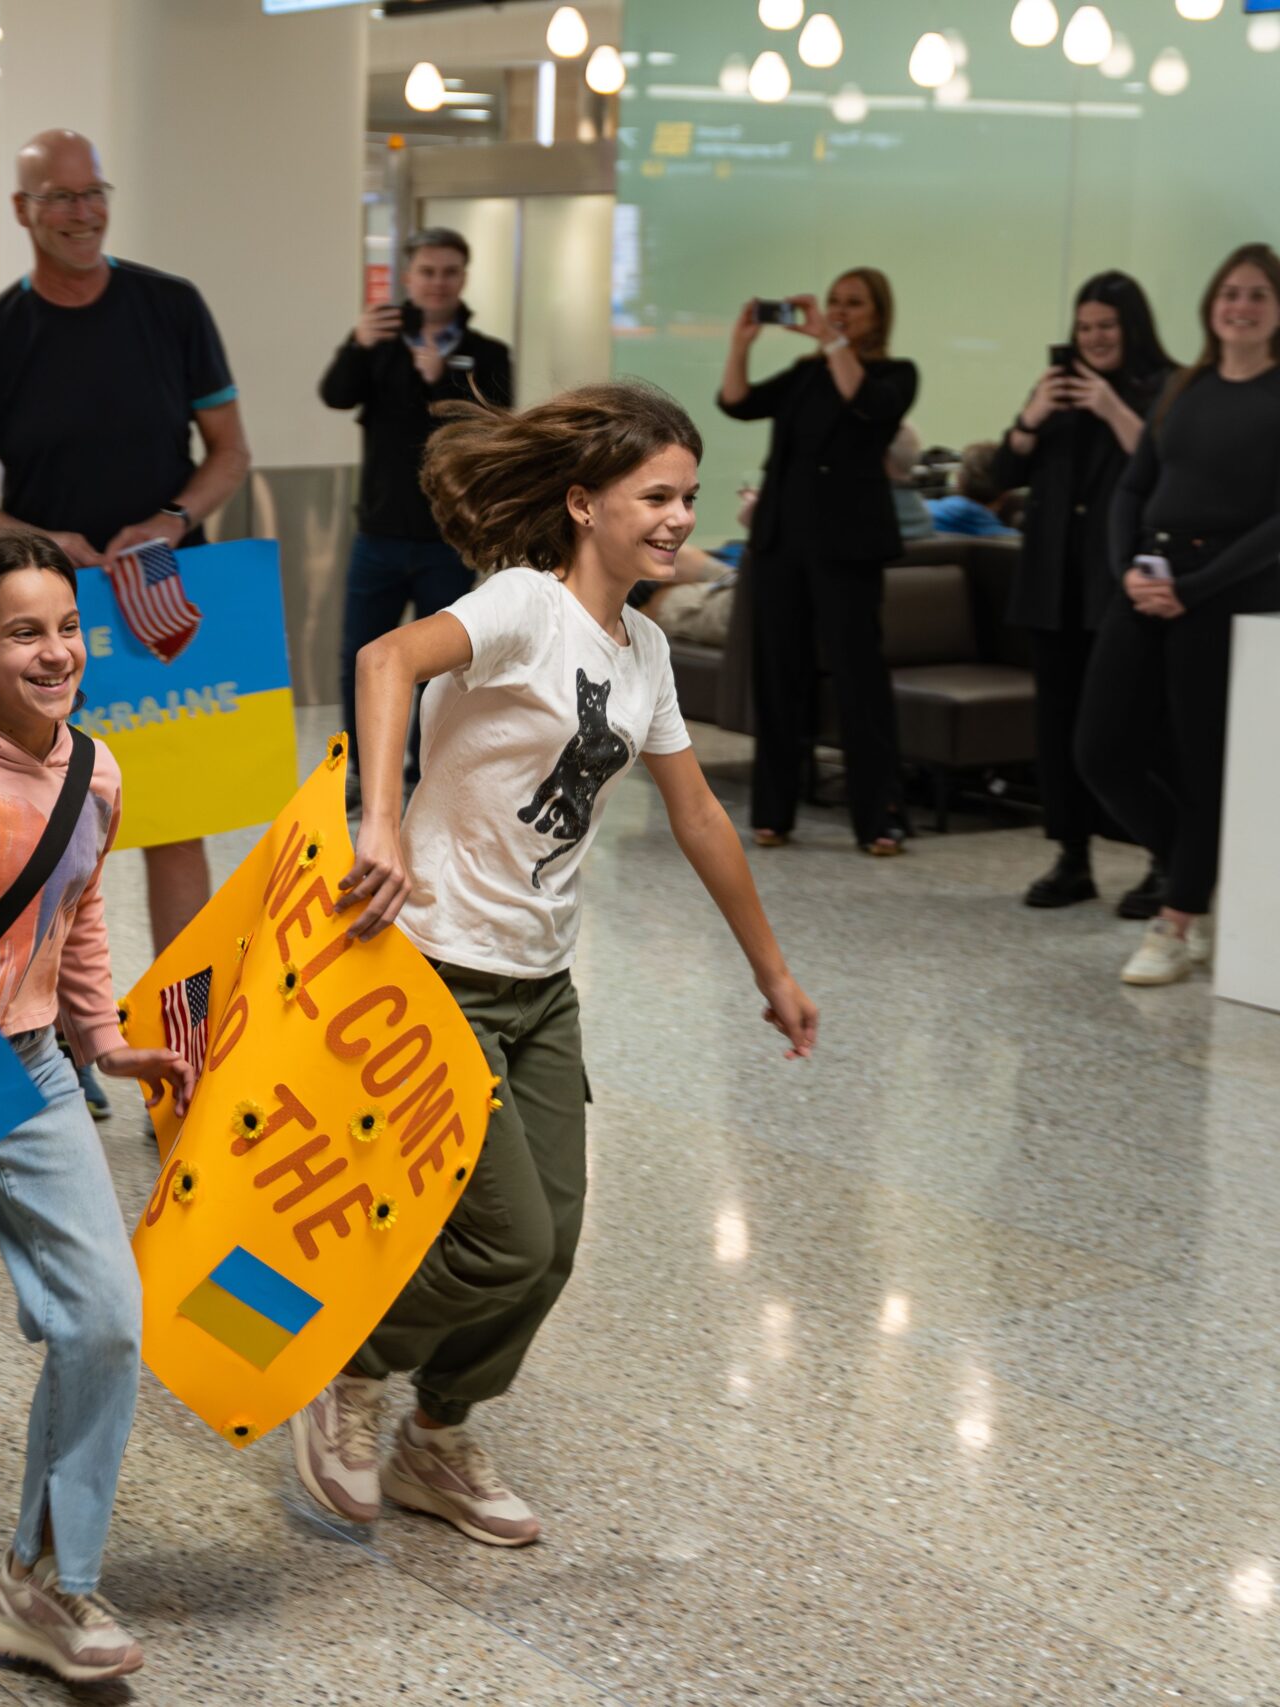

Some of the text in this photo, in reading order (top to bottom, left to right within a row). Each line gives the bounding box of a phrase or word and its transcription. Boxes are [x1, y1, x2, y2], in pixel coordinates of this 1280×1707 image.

[79, 681, 240, 736] KRAINE
[263, 820, 465, 1198] WELCOME
[230, 1083, 375, 1261] THE
